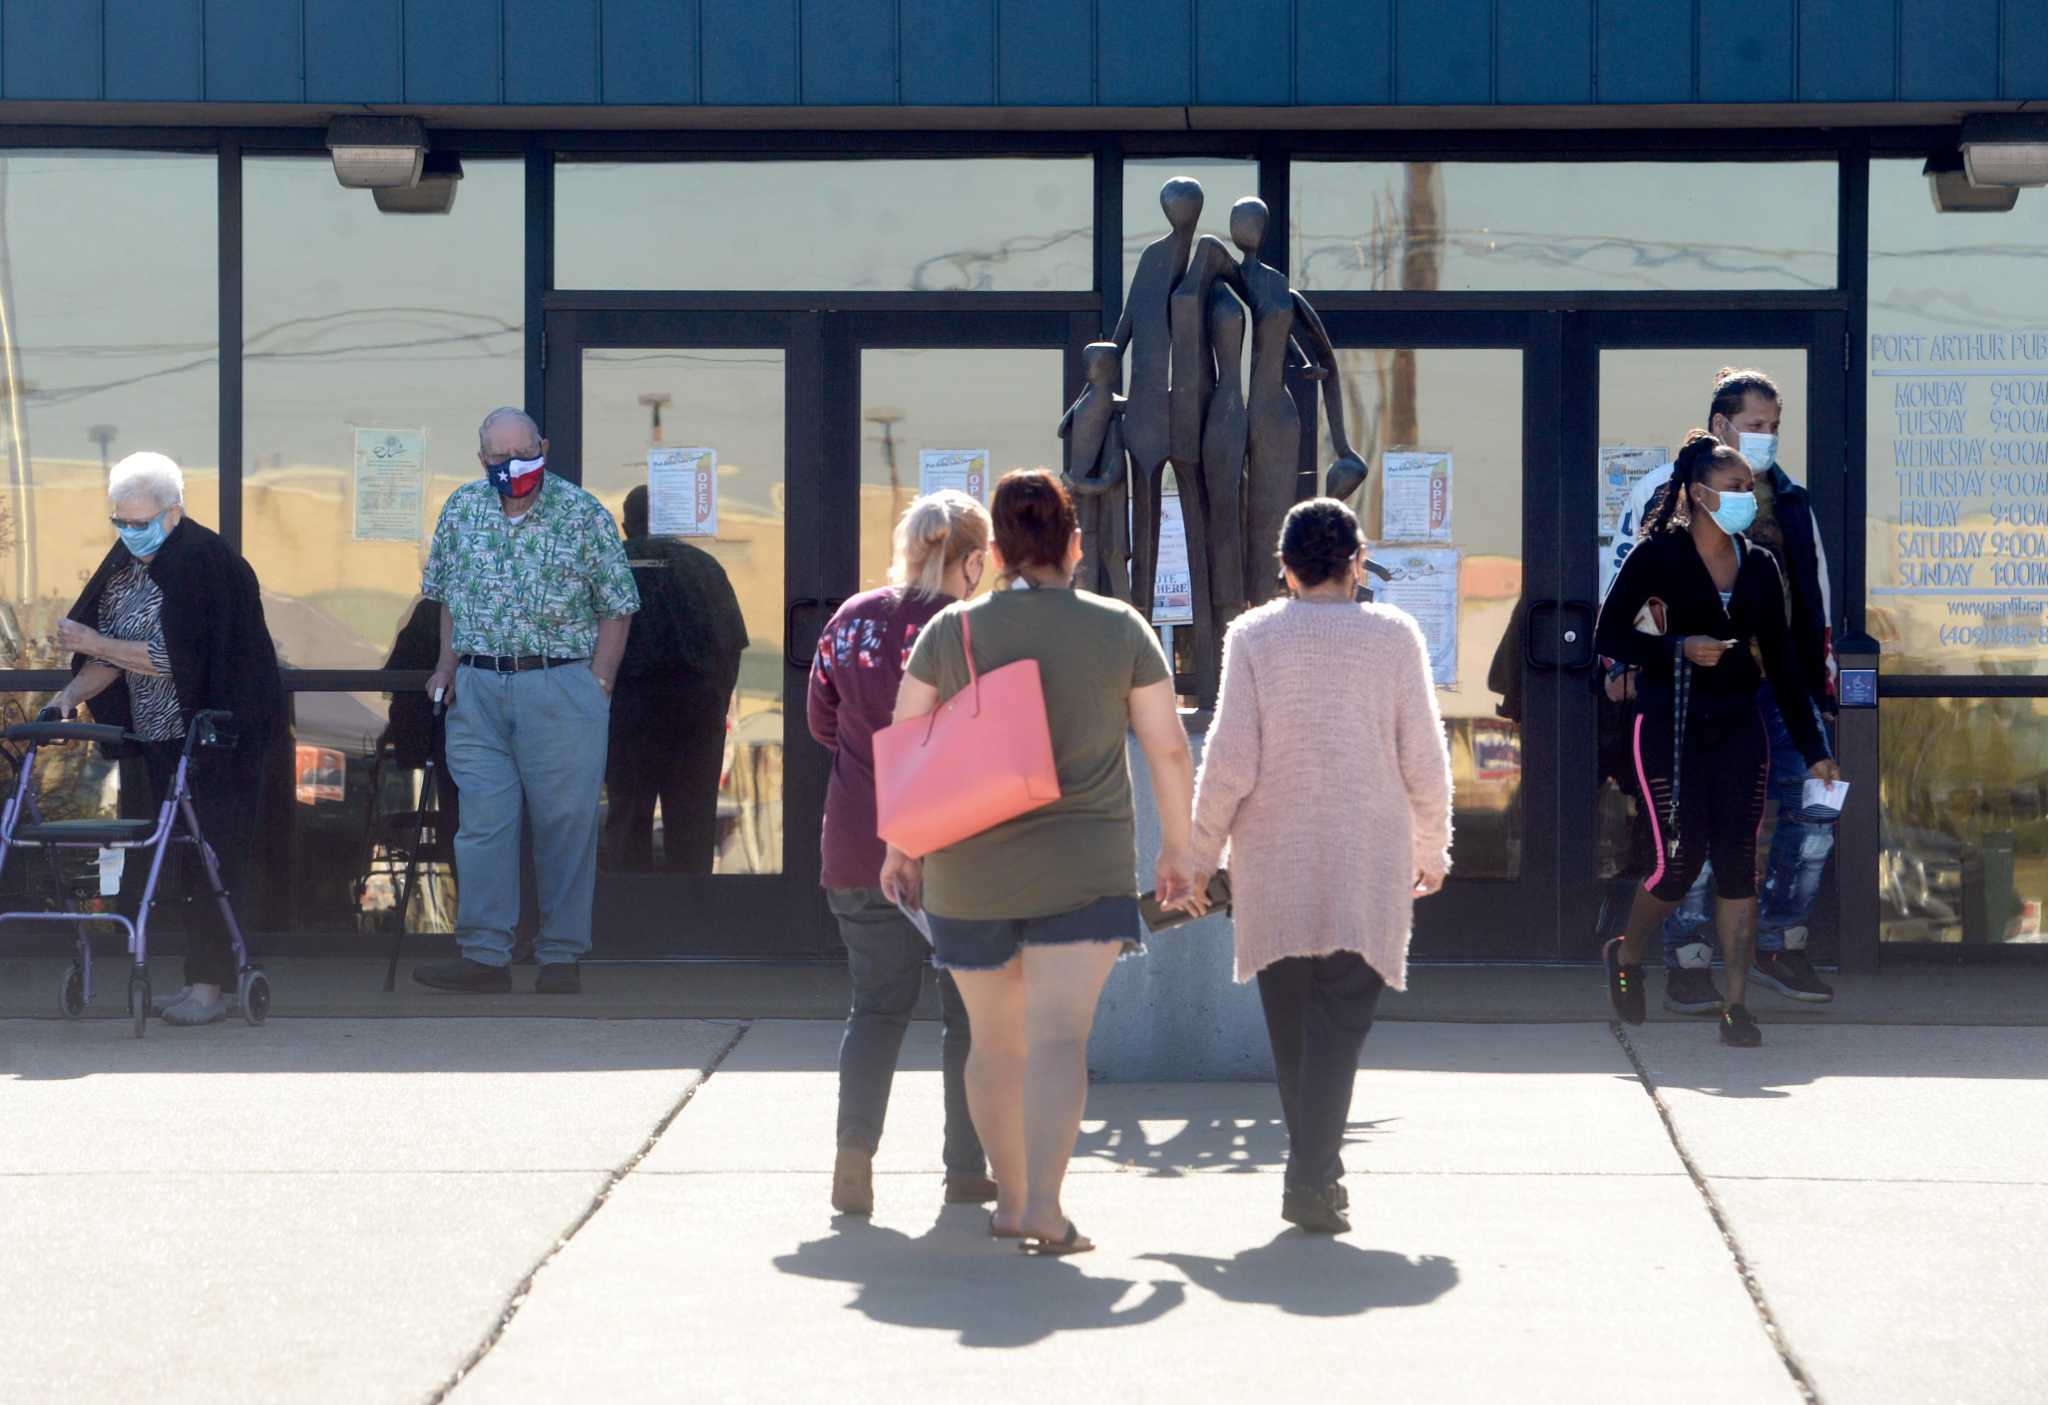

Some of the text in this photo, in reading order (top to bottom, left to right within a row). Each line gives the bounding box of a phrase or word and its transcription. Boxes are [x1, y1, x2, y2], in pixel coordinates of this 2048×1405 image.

[1872, 334, 1926, 361] PORT
[1930, 333, 2006, 360] ARTHUR
[1895, 382, 1967, 408] MONDAY
[1895, 409, 1968, 435] TUESDAY
[1893, 438, 1986, 466] WEDNESDAY
[1895, 470, 1986, 497] THURSDAY
[1432, 479, 1442, 521] OPEN
[1899, 500, 1961, 527] FRIDAY
[1898, 531, 1987, 558] SATURDAY
[1156, 583, 1187, 593] HERE
[1898, 562, 1974, 587] SUNDAY
[1947, 597, 2048, 620] www.paplibrar
